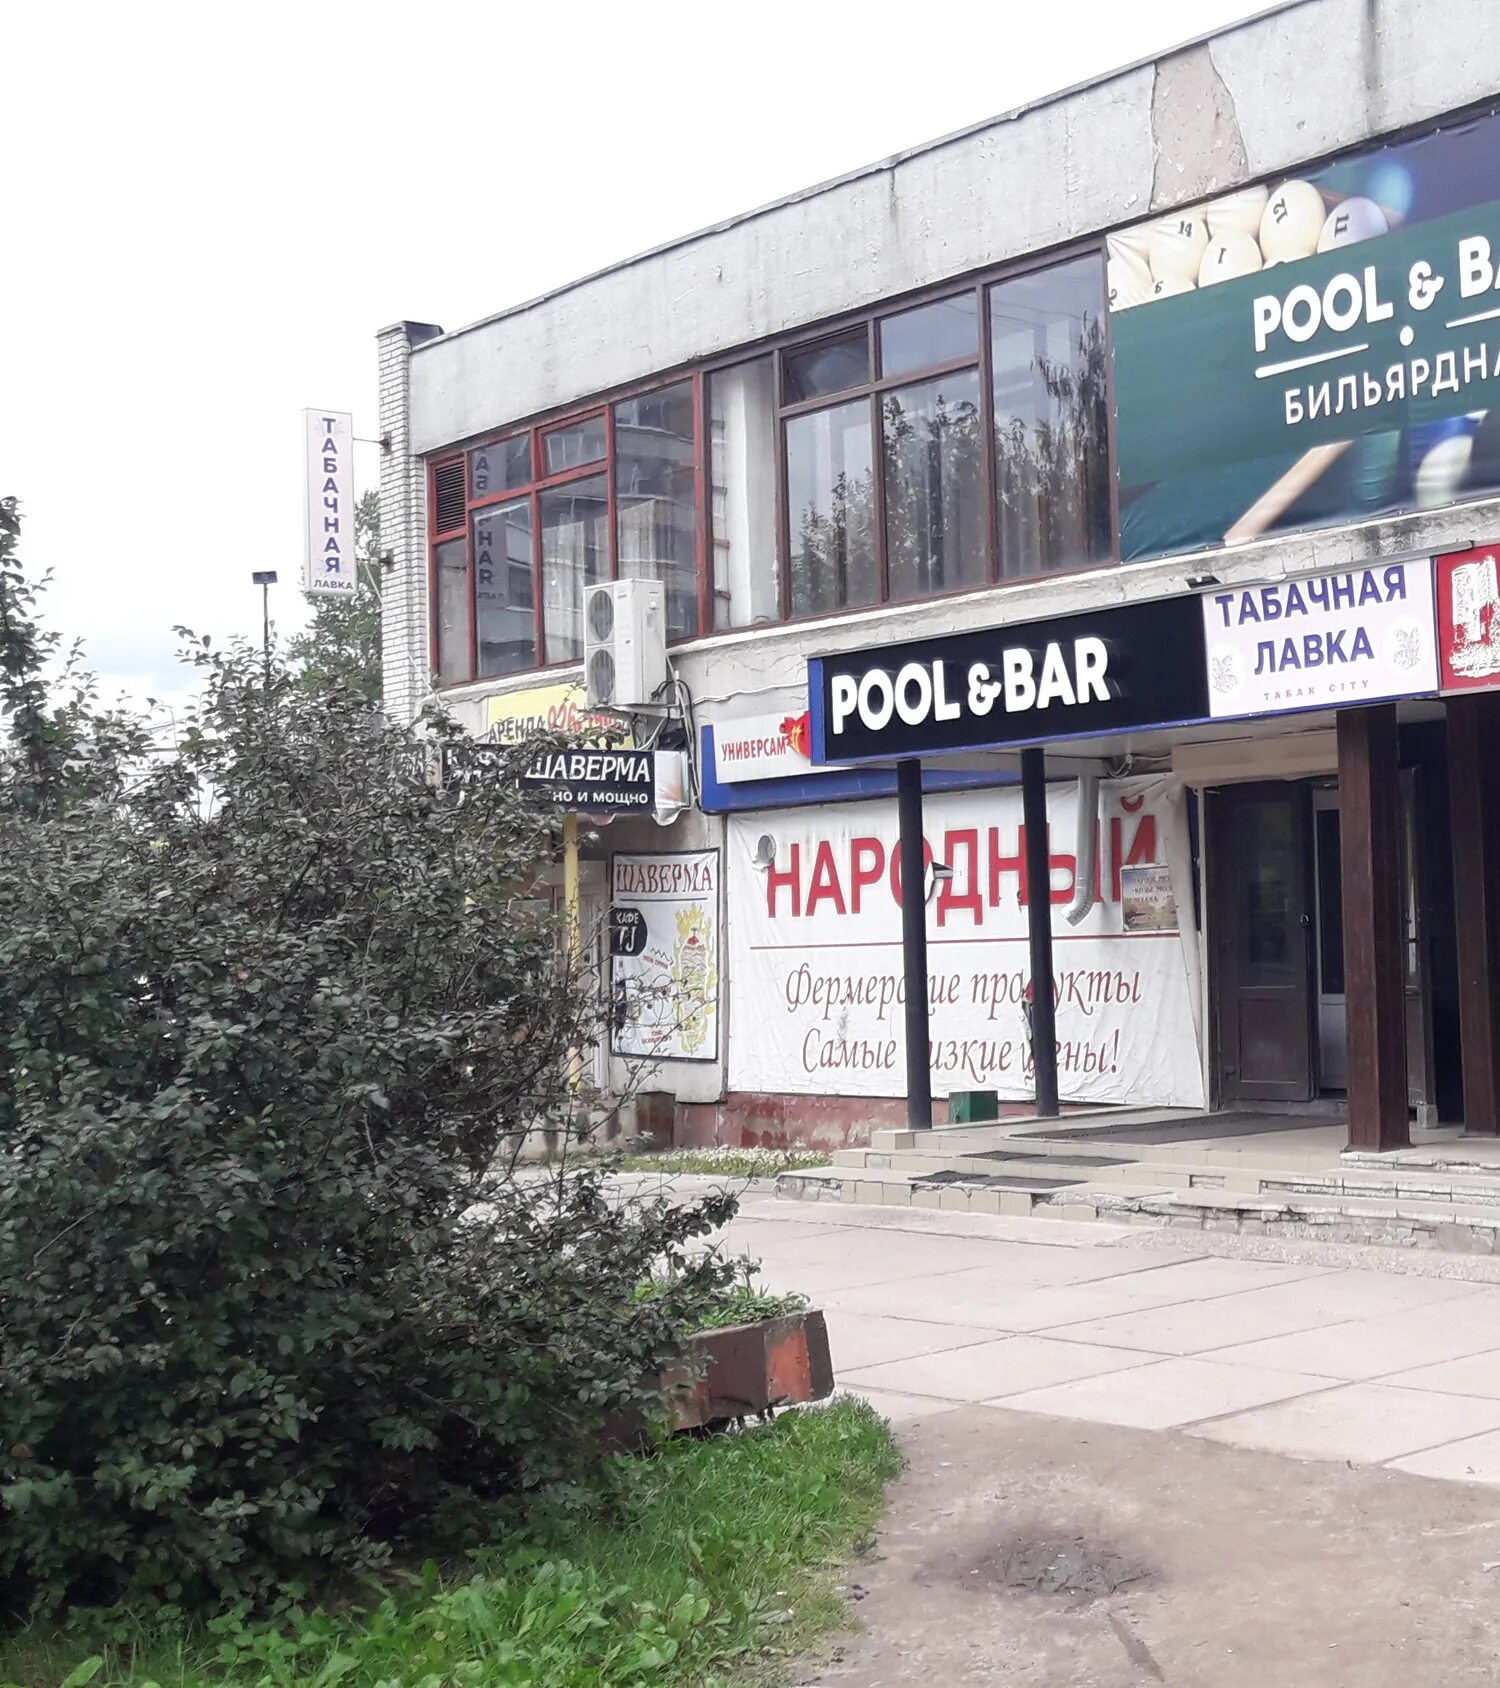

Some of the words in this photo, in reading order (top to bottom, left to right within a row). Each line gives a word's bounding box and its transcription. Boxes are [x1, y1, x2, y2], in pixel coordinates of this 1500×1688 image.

[1253, 266, 1394, 353] POOL
[1408, 260, 1445, 311] &
[321, 417, 341, 573] ТАБАЧНАЯ
[313, 579, 353, 590] ЛАВКА
[1215, 565, 1407, 627] ТАБАЧНАЯ
[1254, 627, 1375, 675] ЛАВКА
[831, 660, 961, 735] POOL
[1003, 637, 1111, 713] BAR
[1264, 687, 1315, 701] ТАБАК
[1329, 680, 1369, 692] CITY
[524, 754, 652, 783] ШАВЕРМА
[721, 735, 787, 761] УНИВЕРСАМ
[616, 863, 714, 893] ШАВЕРМА
[767, 795, 1156, 927] НАРОДНЫЙ
[616, 911, 639, 924] КАФЕ
[971, 969, 1141, 1020] проукты
[802, 1028, 897, 1073] Самые
[926, 1039, 1013, 1083] изкие
